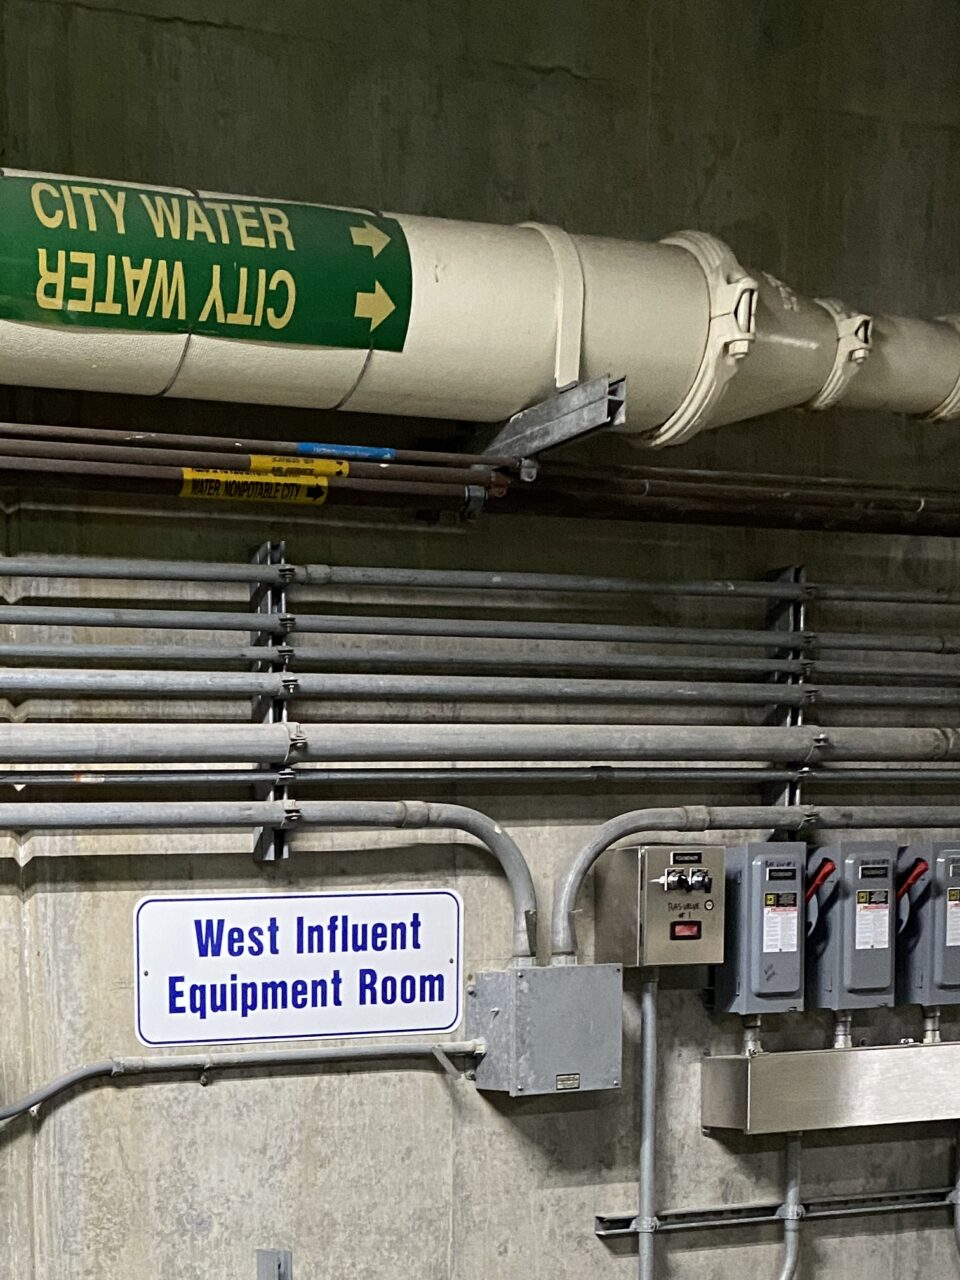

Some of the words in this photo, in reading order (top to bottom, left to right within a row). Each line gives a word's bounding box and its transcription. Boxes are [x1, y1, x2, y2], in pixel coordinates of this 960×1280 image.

[30, 182, 127, 235] CITY
[140, 193, 296, 251] WATER
[35, 247, 188, 321] WATER
[198, 264, 297, 330] CITY
[194, 916, 280, 958] West
[296, 912, 422, 954] Influent
[168, 970, 342, 1020] Equipment
[359, 967, 445, 1006] Room
